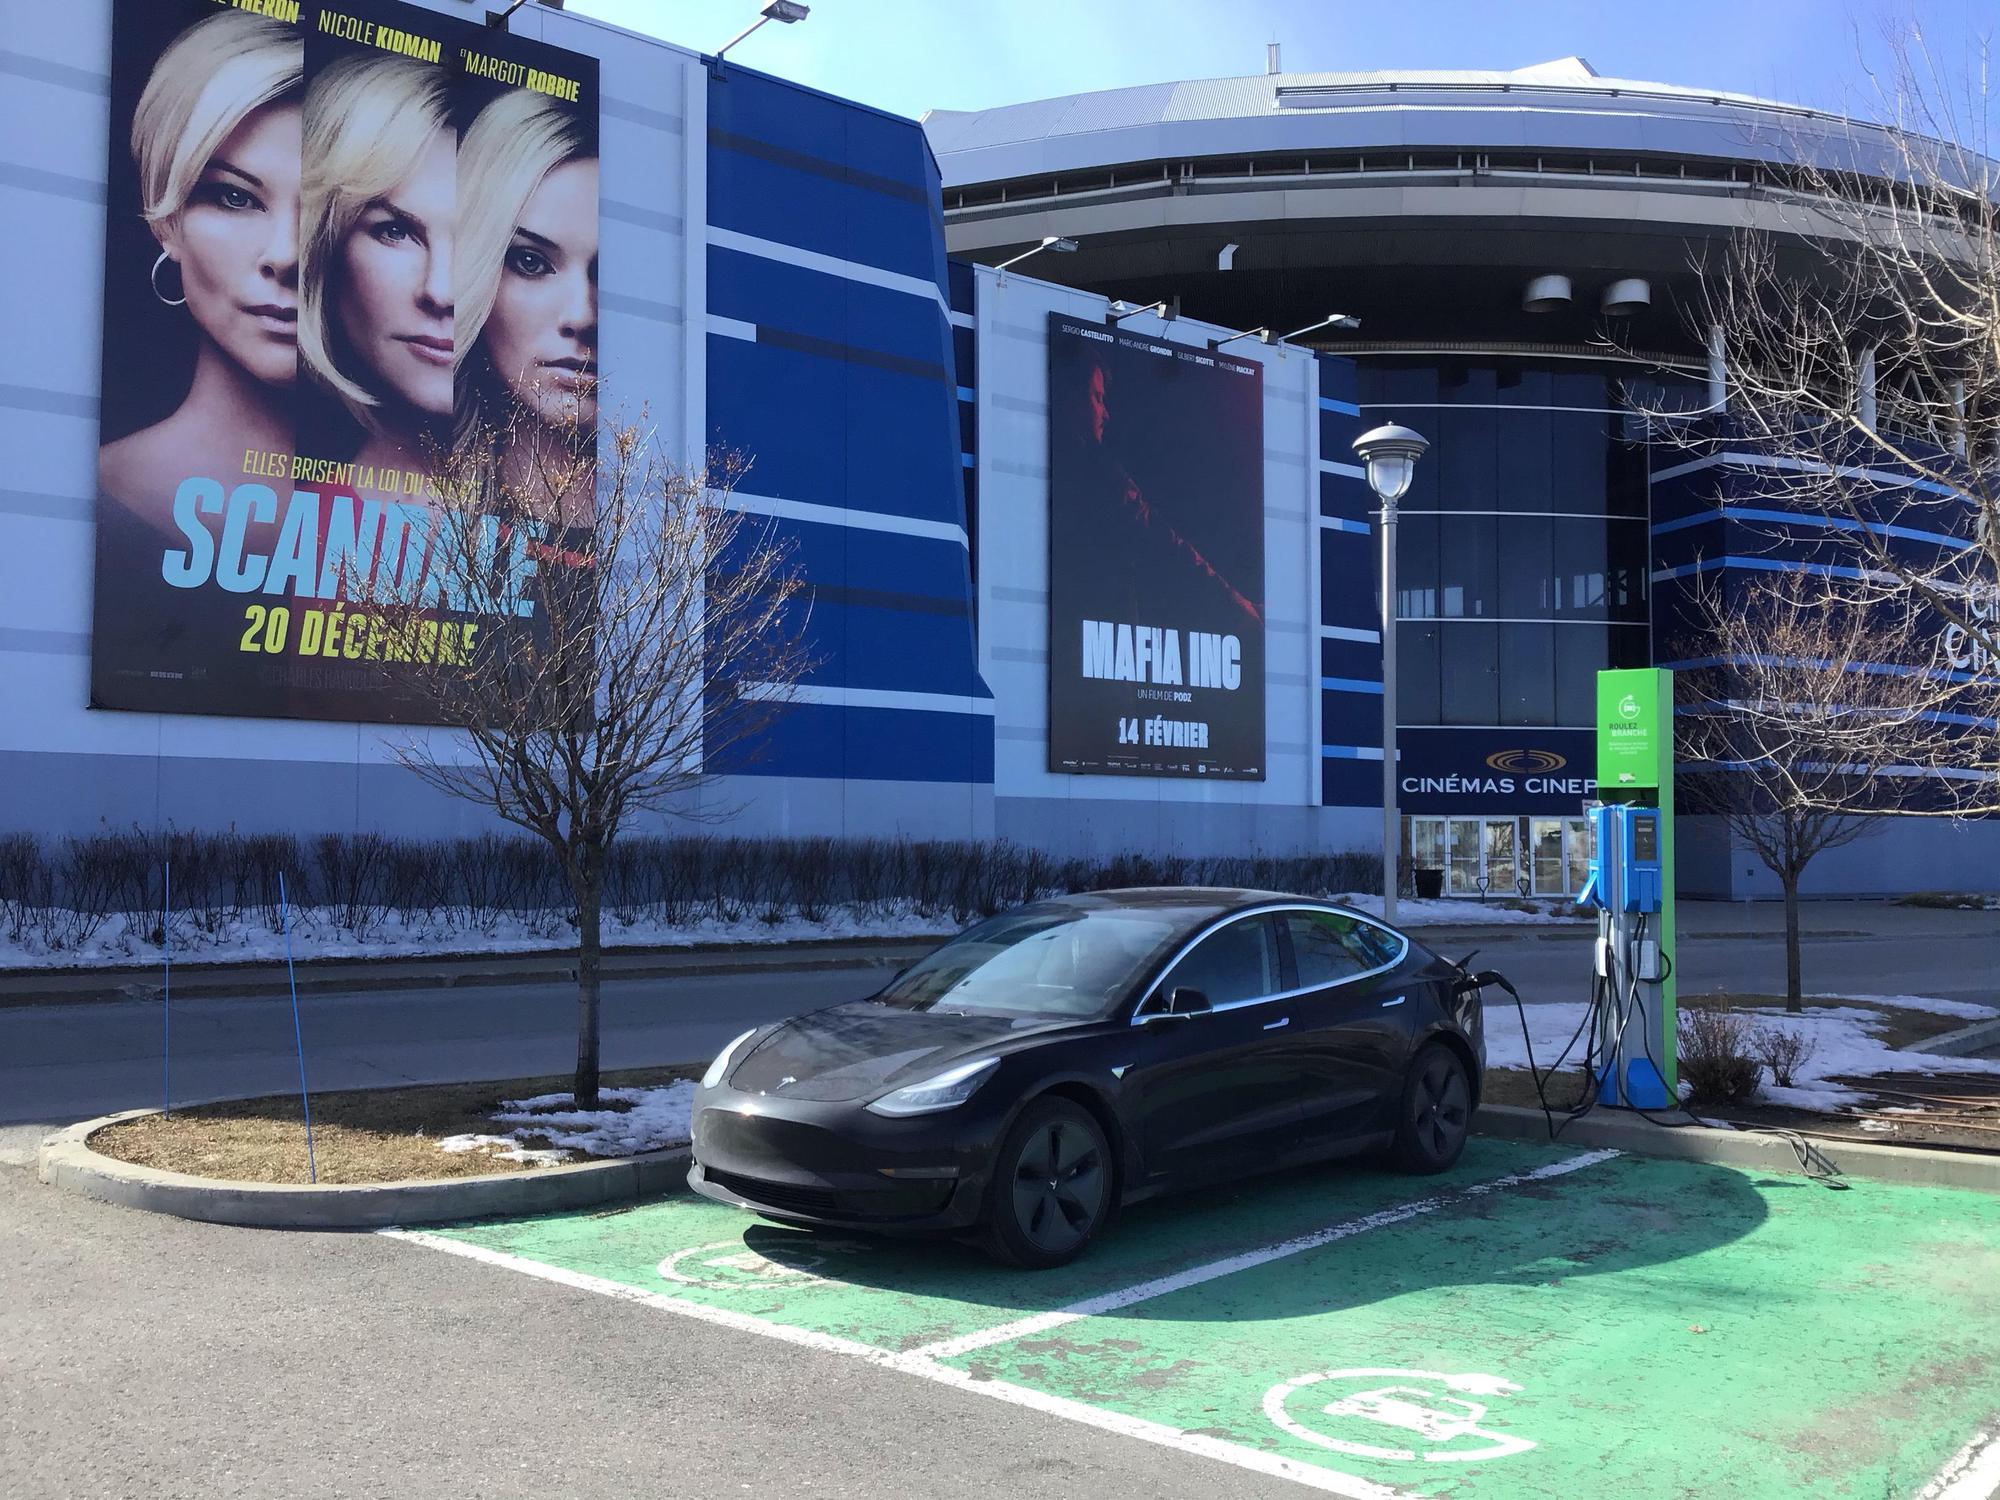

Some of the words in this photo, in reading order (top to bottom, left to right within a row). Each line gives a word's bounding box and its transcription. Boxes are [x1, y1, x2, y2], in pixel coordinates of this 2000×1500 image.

[318, 9, 375, 45] NICOLE
[375, 25, 442, 64] KIDMAN
[465, 50, 526, 87] MARGOT
[526, 68, 581, 103] ROBBIE
[243, 448, 287, 478] ELLES
[290, 455, 356, 486] BRISENT
[356, 464, 374, 489] LA
[378, 468, 400, 493] LOI
[403, 471, 424, 497] DU
[239, 604, 290, 654] 20
[1082, 619, 1184, 686] MAFIA
[1189, 631, 1241, 691] INC
[1137, 689, 1148, 699] UN
[1149, 689, 1164, 701] FILM
[1164, 690, 1173, 701] DE
[1118, 717, 1139, 745] 14
[1145, 714, 1209, 748] FÉVRIER
[1609, 722, 1638, 730] ROULEZ
[1401, 773, 1515, 794] CINÉMAS
